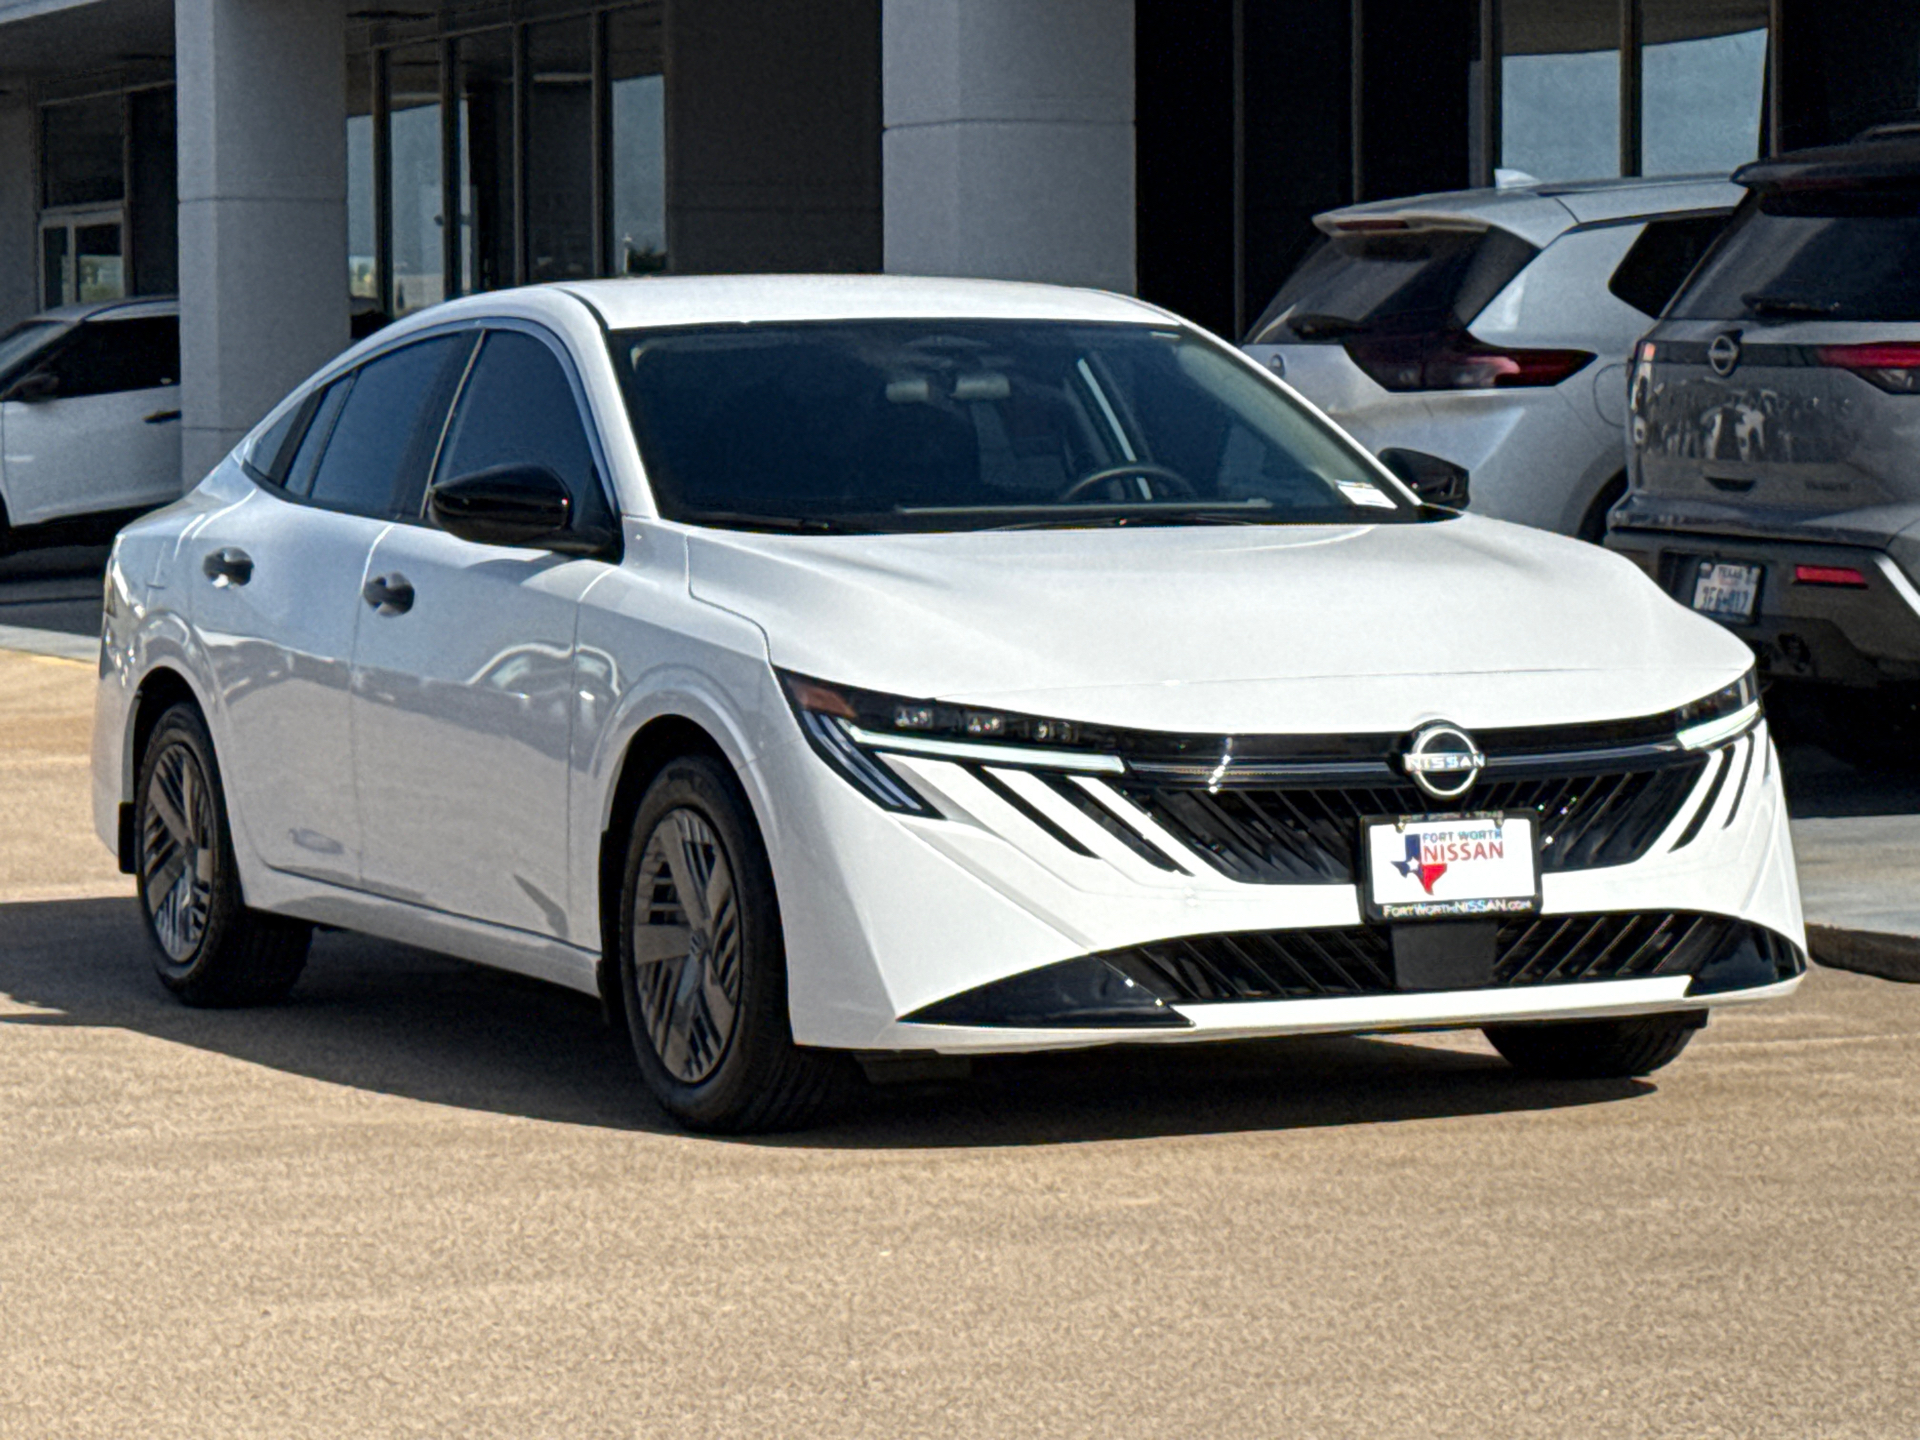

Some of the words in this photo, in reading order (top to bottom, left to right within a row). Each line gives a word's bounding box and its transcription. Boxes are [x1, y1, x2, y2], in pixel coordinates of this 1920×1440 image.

[1403, 752, 1485, 773] NISSAN
[1423, 831, 1454, 843] FORT
[1458, 829, 1503, 841] WORTH
[1424, 841, 1504, 862] NISSAN
